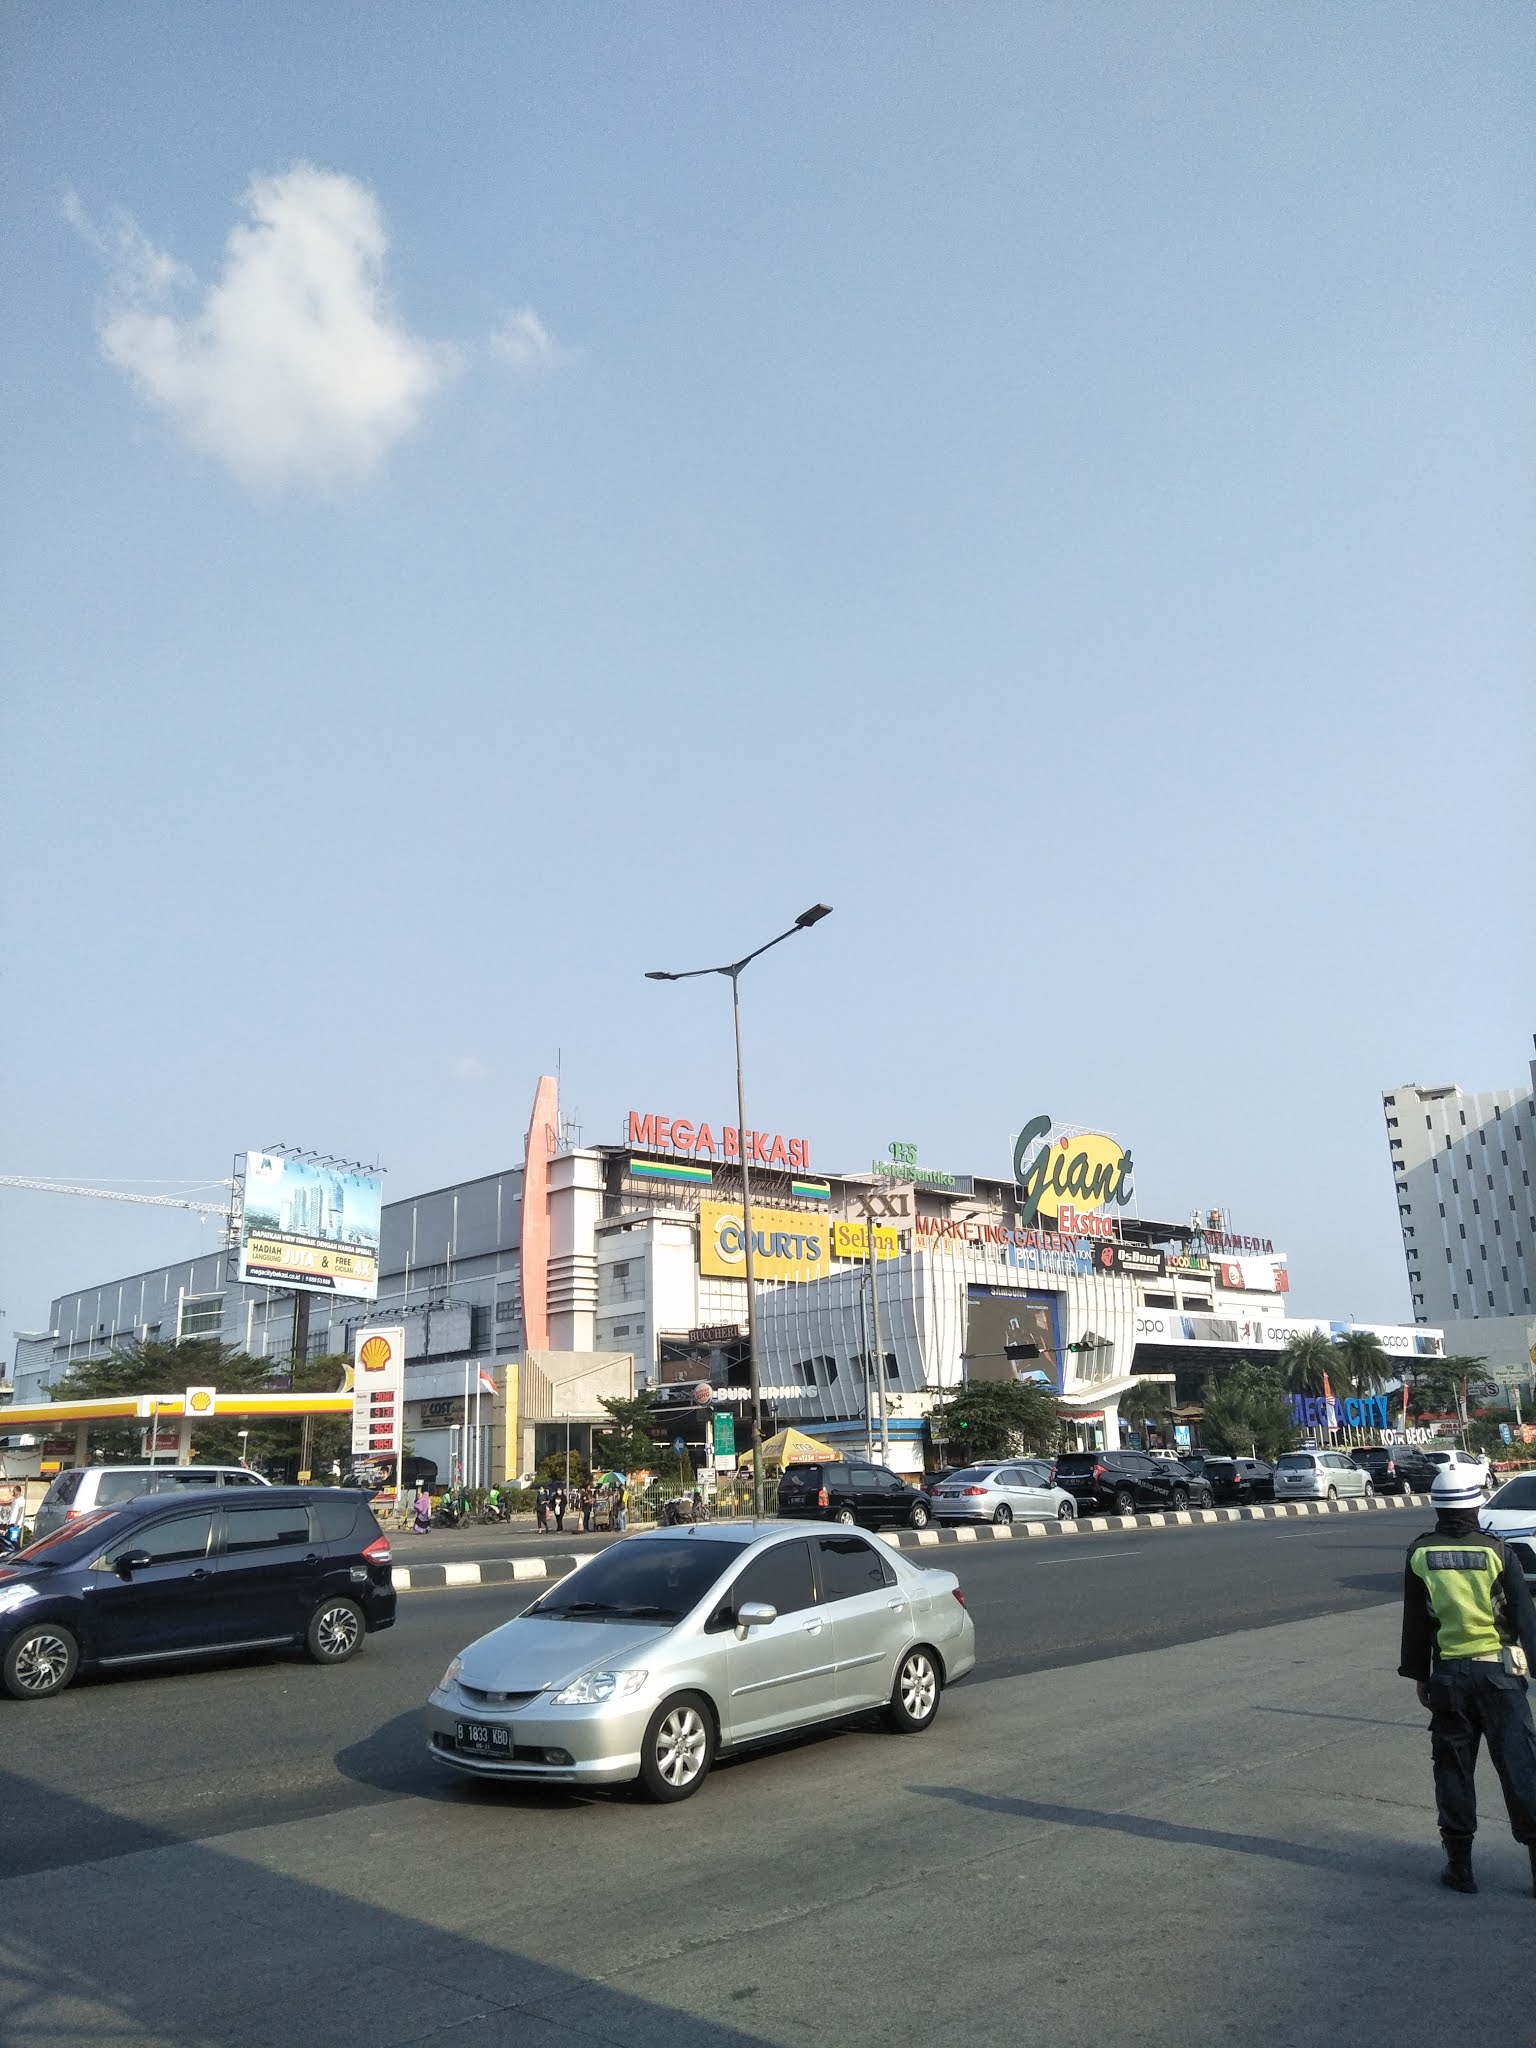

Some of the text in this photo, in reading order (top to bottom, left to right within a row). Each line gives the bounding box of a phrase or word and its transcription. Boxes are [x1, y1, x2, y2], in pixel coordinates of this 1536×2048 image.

[628, 1111, 716, 1154] MEGA
[872, 1159, 956, 1187] Hotel Santika
[1013, 1114, 1134, 1226] Giant
[856, 1193, 911, 1217] XXI
[1059, 1205, 1113, 1237] Ekstra
[720, 1226, 822, 1261] COURTS
[838, 1225, 895, 1251] Selna
[915, 1215, 1011, 1245] MARKETING
[1013, 1227, 1079, 1253] GALLERY
[1205, 1230, 1274, 1253] GRAMEDIA
[252, 1243, 282, 1255] HADIAH
[252, 1253, 281, 1263] LANGSUNG
[1117, 1249, 1161, 1265] OsBond
[335, 1256, 352, 1266] FREE
[990, 1286, 1027, 1298] SAMSUNG
[689, 1326, 738, 1342] BUCCHERI
[1267, 1327, 1299, 1343] oppo
[1382, 1335, 1409, 1348] oppo
[458, 1724, 464, 1739] B
[468, 1725, 488, 1742] 1833
